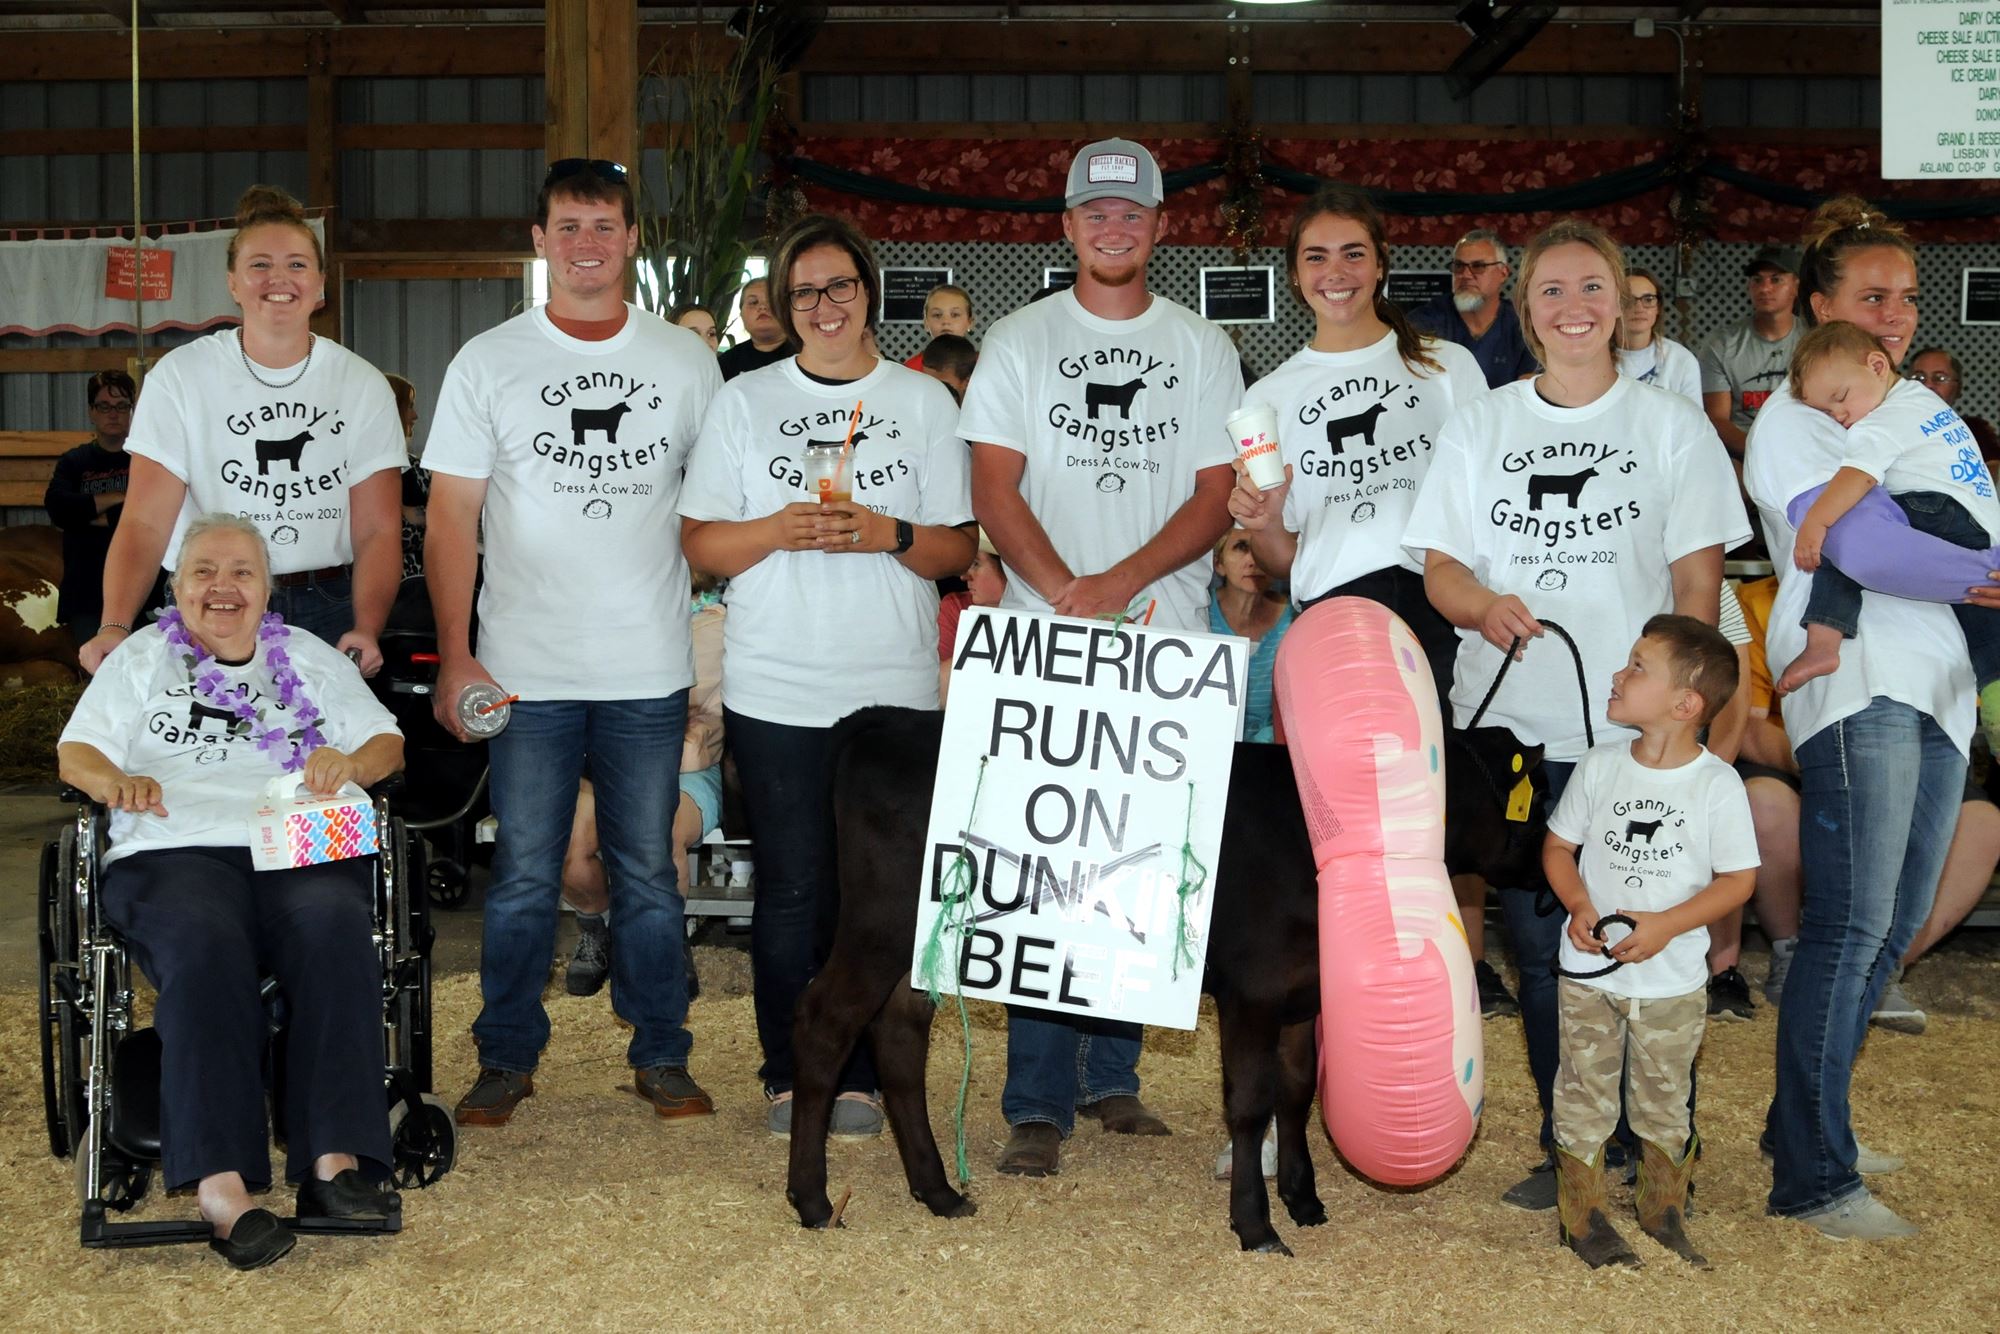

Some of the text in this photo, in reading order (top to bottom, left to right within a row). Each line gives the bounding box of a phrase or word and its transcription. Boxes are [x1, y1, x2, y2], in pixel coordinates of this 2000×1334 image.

[1959, 11, 1983, 25] DAIRY
[1917, 30, 1949, 45] CHEESE
[1952, 30, 1972, 44] SALE
[1936, 49, 1969, 63] CHEESE
[1972, 49, 1993, 63] SALE
[1951, 68, 1997, 82] ICE CREAM
[1937, 132, 1966, 146] GRAND
[1952, 148, 1990, 159] LISBON
[1919, 162, 1954, 173] AGLAND
[1958, 161, 1986, 173] CO-OP
[1058, 347, 1179, 390] Granny's
[540, 371, 663, 410] Granny's
[1298, 376, 1420, 425] Granny's
[226, 401, 345, 436] Granny's
[1048, 403, 1179, 453] Gangsters
[532, 431, 669, 479] Gangsters
[1066, 455, 1099, 467] Dress
[1101, 457, 1111, 467] A
[1114, 457, 1141, 470] Cow
[1300, 433, 1432, 485] Gangsters
[1502, 441, 1638, 474] Granny's
[553, 481, 653, 495] Dress A Cow 2021
[768, 455, 909, 492] Gaters
[1354, 488, 1364, 500] A
[1366, 480, 1389, 497] Cow
[1392, 478, 1416, 491] 2021
[275, 510, 284, 521] A
[287, 509, 314, 521] Cow
[317, 508, 342, 519] 2021
[1490, 498, 1641, 548] Gangsters
[1543, 552, 1553, 563] A
[1557, 551, 1588, 564] Cow
[1591, 551, 1617, 564] 2021
[954, 614, 1239, 706] AMERICA
[989, 697, 1189, 782] RUNS
[1025, 783, 1131, 852] ON
[1613, 799, 1686, 828] Granny's
[1604, 830, 1684, 864] Gangsters
[1609, 862, 1628, 872] Dress
[1637, 867, 1654, 876] Cow
[1655, 869, 1672, 878] 2021
